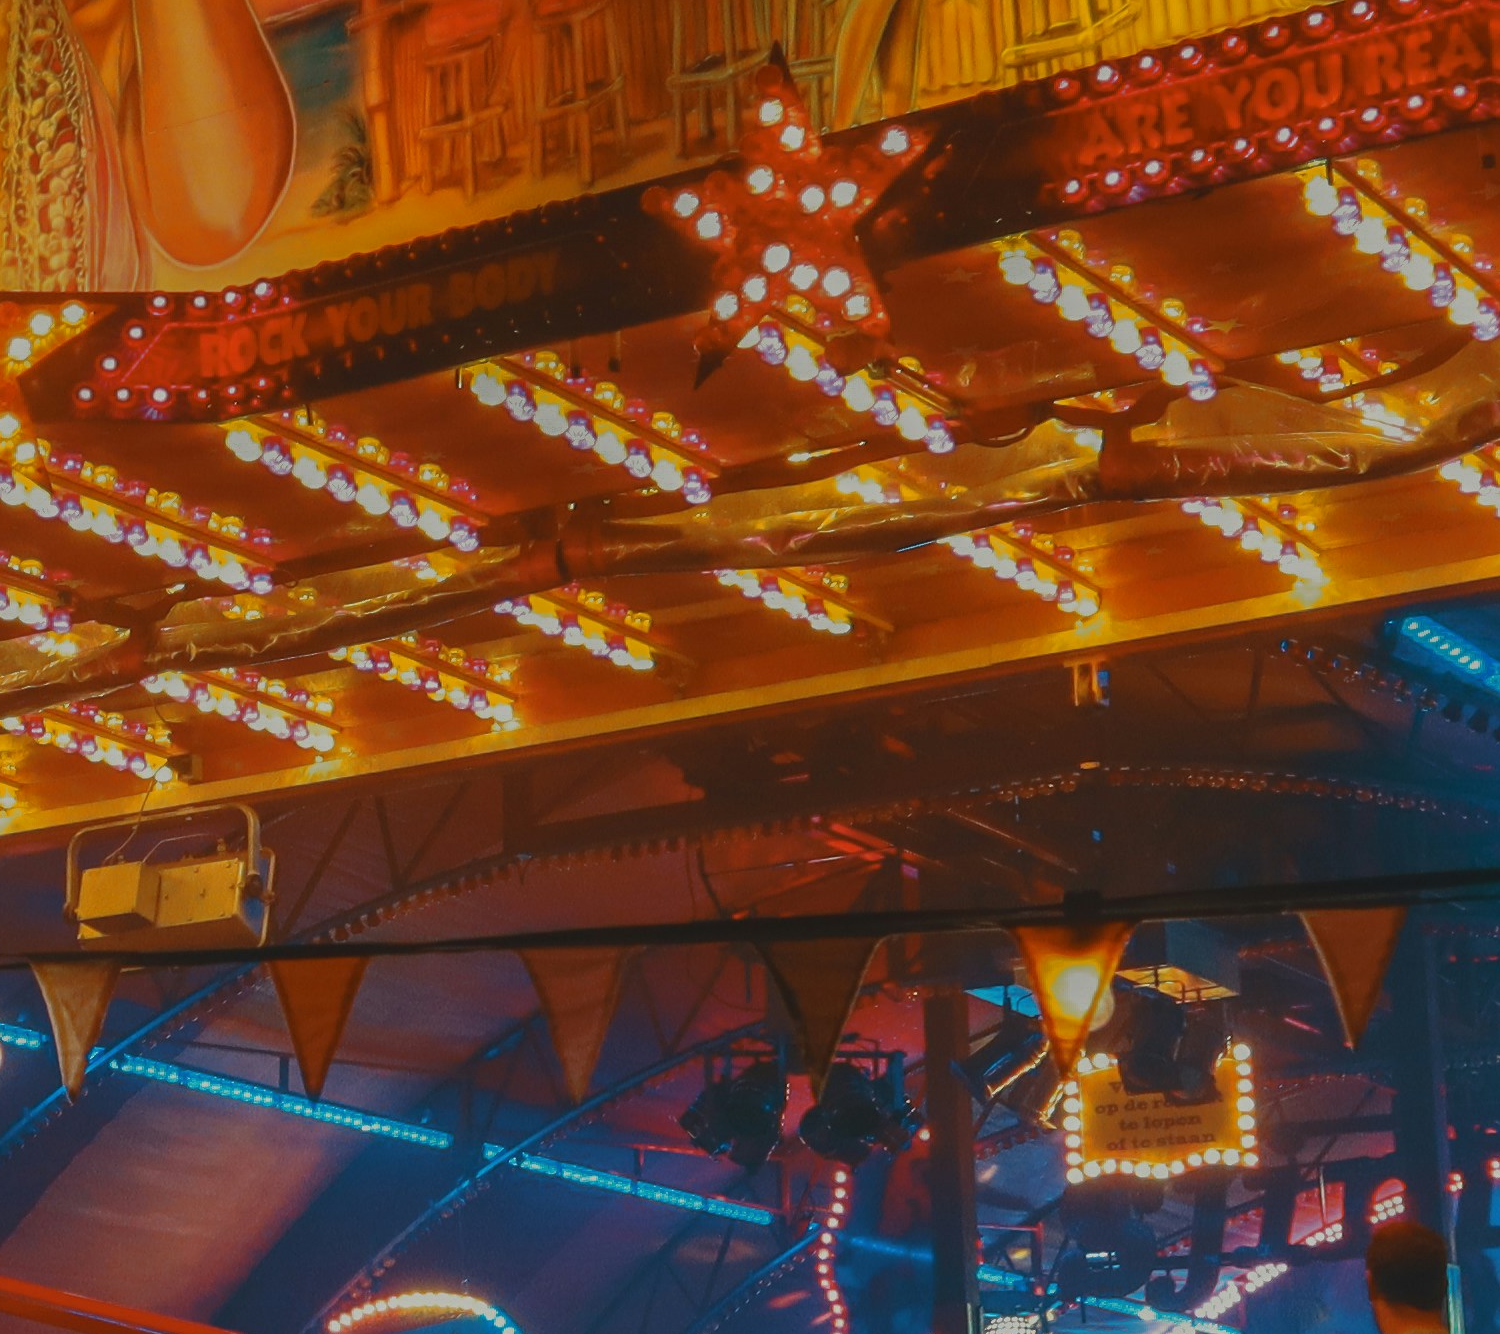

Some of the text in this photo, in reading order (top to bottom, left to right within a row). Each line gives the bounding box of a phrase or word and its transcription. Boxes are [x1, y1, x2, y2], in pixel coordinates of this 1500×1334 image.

[1078, 83, 1193, 166] ARE
[1213, 51, 1343, 132] YOU
[199, 247, 562, 378] ROCK YOUR BODY
[1095, 1103, 1119, 1116] op
[1124, 1099, 1147, 1112] de
[1142, 1115, 1202, 1130] lopen
[1106, 1137, 1127, 1150] of
[1156, 1132, 1217, 1146] staan
